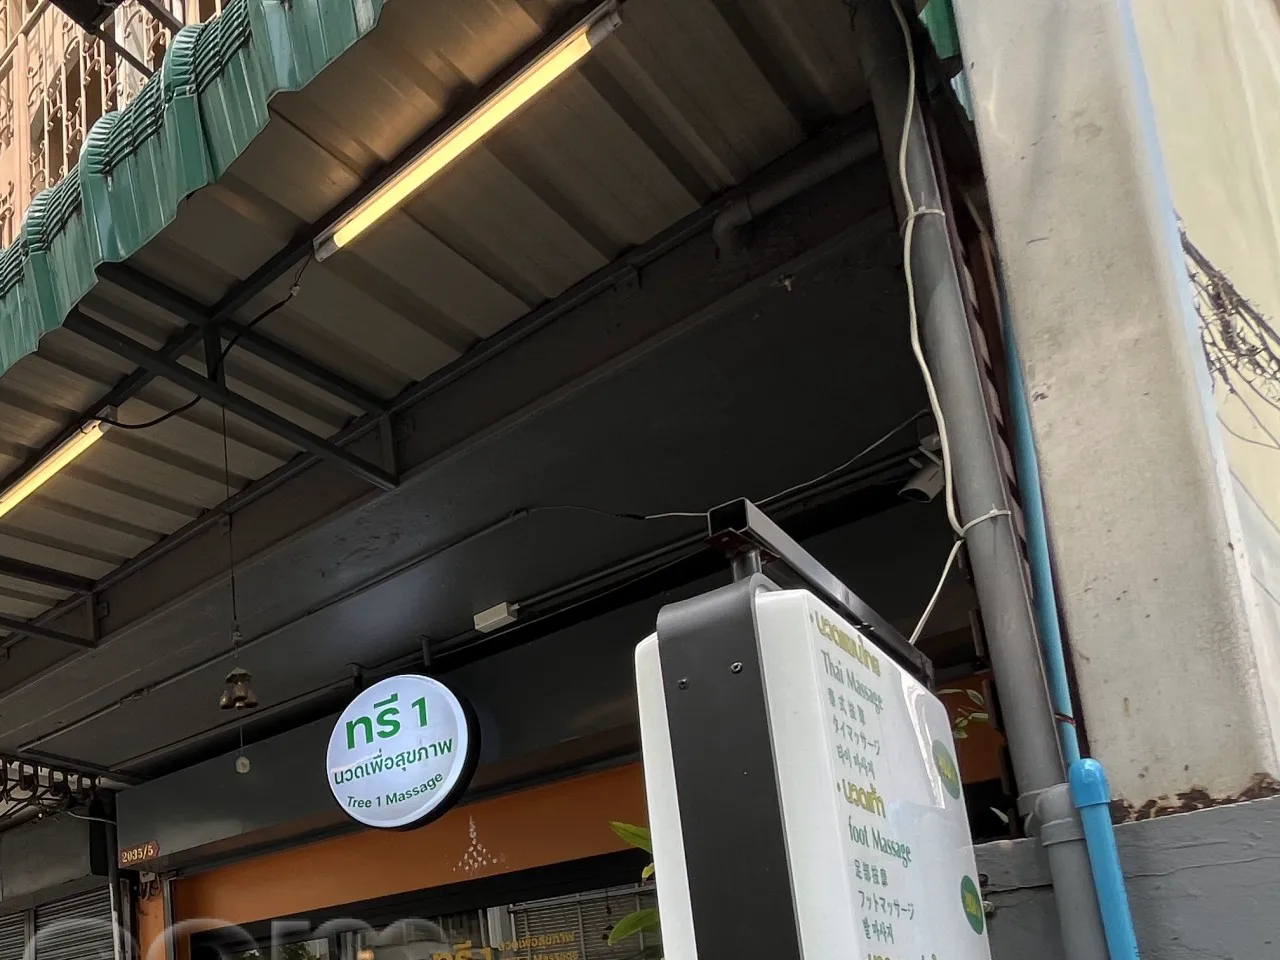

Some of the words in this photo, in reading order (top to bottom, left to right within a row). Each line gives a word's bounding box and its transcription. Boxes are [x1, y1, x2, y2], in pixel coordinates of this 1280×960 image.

[820, 650, 844, 686] Thai
[846, 667, 883, 714] Massage
[345, 693, 401, 750] ทรี
[411, 696, 428, 727] 1
[334, 738, 453, 785] นวดเพื่อสุขภาพ
[347, 796, 372, 808] Tree
[375, 796, 382, 807] 1
[386, 772, 444, 805] Massage
[122, 844, 154, 863] 2035/5
[872, 827, 912, 868] Massage
